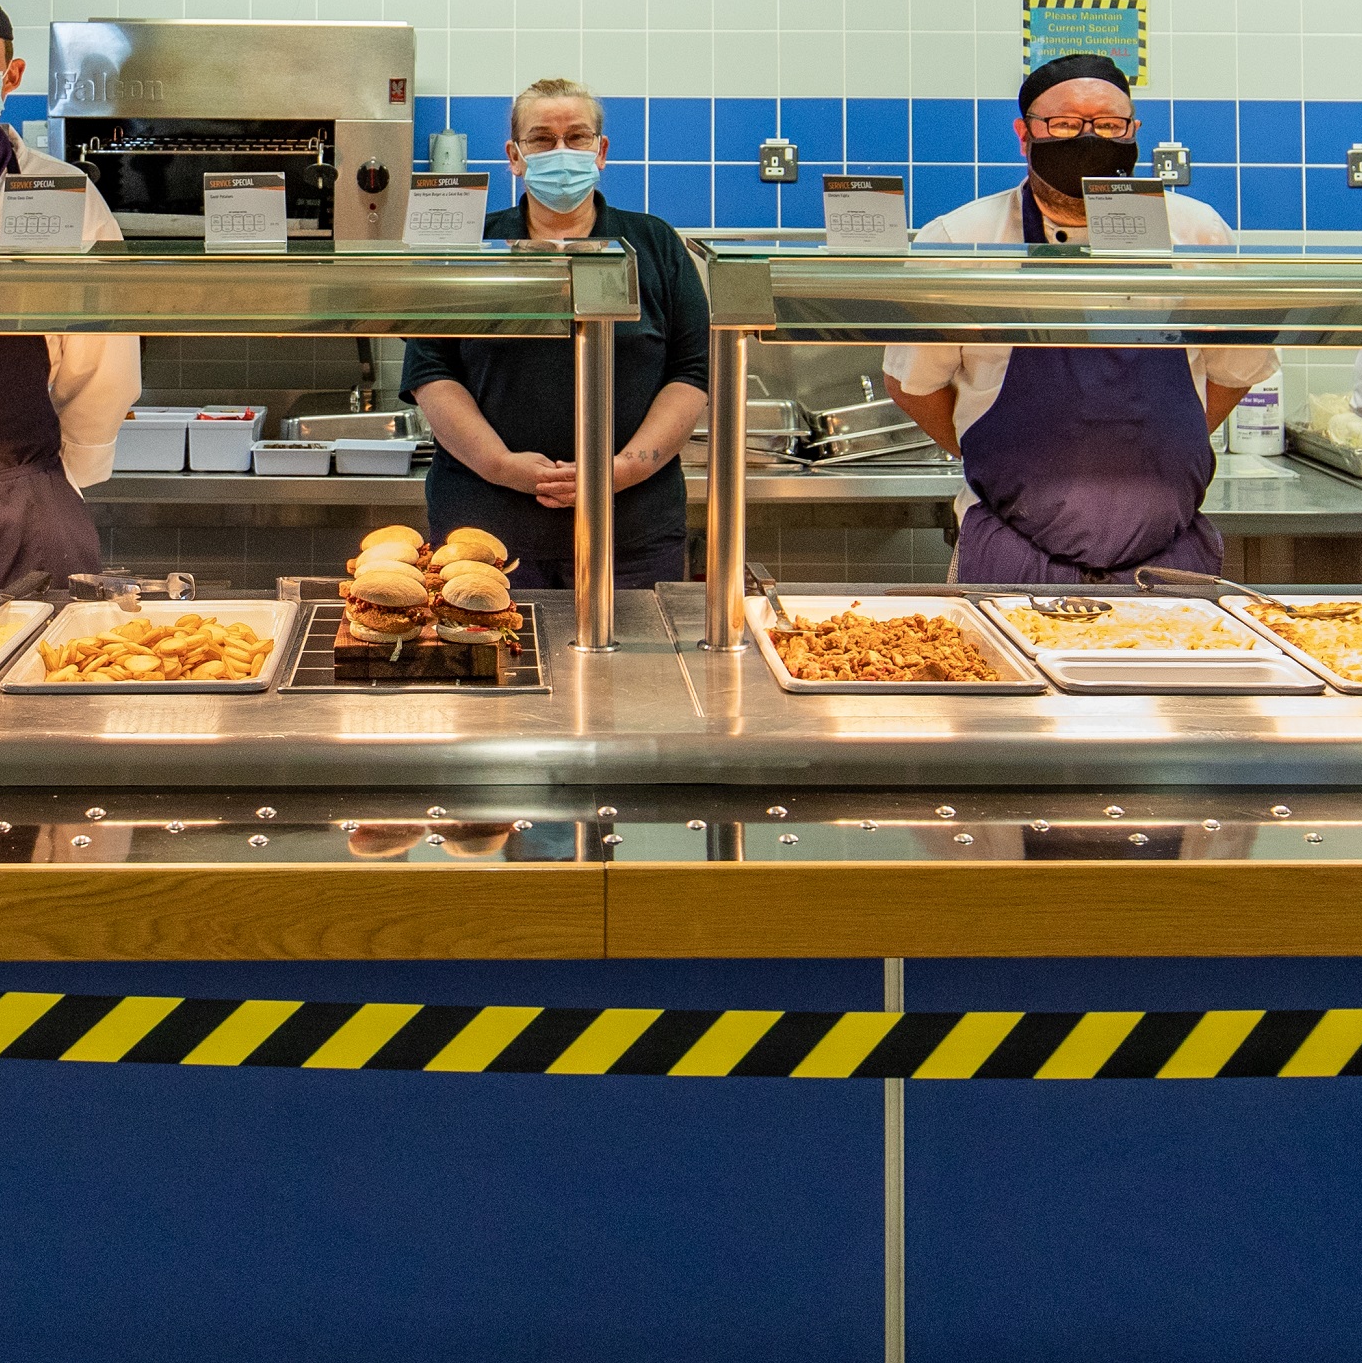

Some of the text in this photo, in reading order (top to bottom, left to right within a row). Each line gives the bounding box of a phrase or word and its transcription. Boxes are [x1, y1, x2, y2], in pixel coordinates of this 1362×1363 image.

[1044, 11, 1123, 20] Please Maintain
[1048, 23, 1119, 32] Current Social
[1030, 35, 1138, 46] Distancing Guidelines
[1039, 47, 1131, 56] and Adhere to ALL
[54, 72, 164, 101] Falcon
[10, 180, 55, 189] SERVICE SPECIAL
[209, 178, 254, 188] SERVICE SPECIAL
[416, 178, 459, 187] SERVICE SPECIAL
[850, 181, 873, 189] SPECIAL
[1088, 184, 1133, 192] SERVICE SPECIAL
